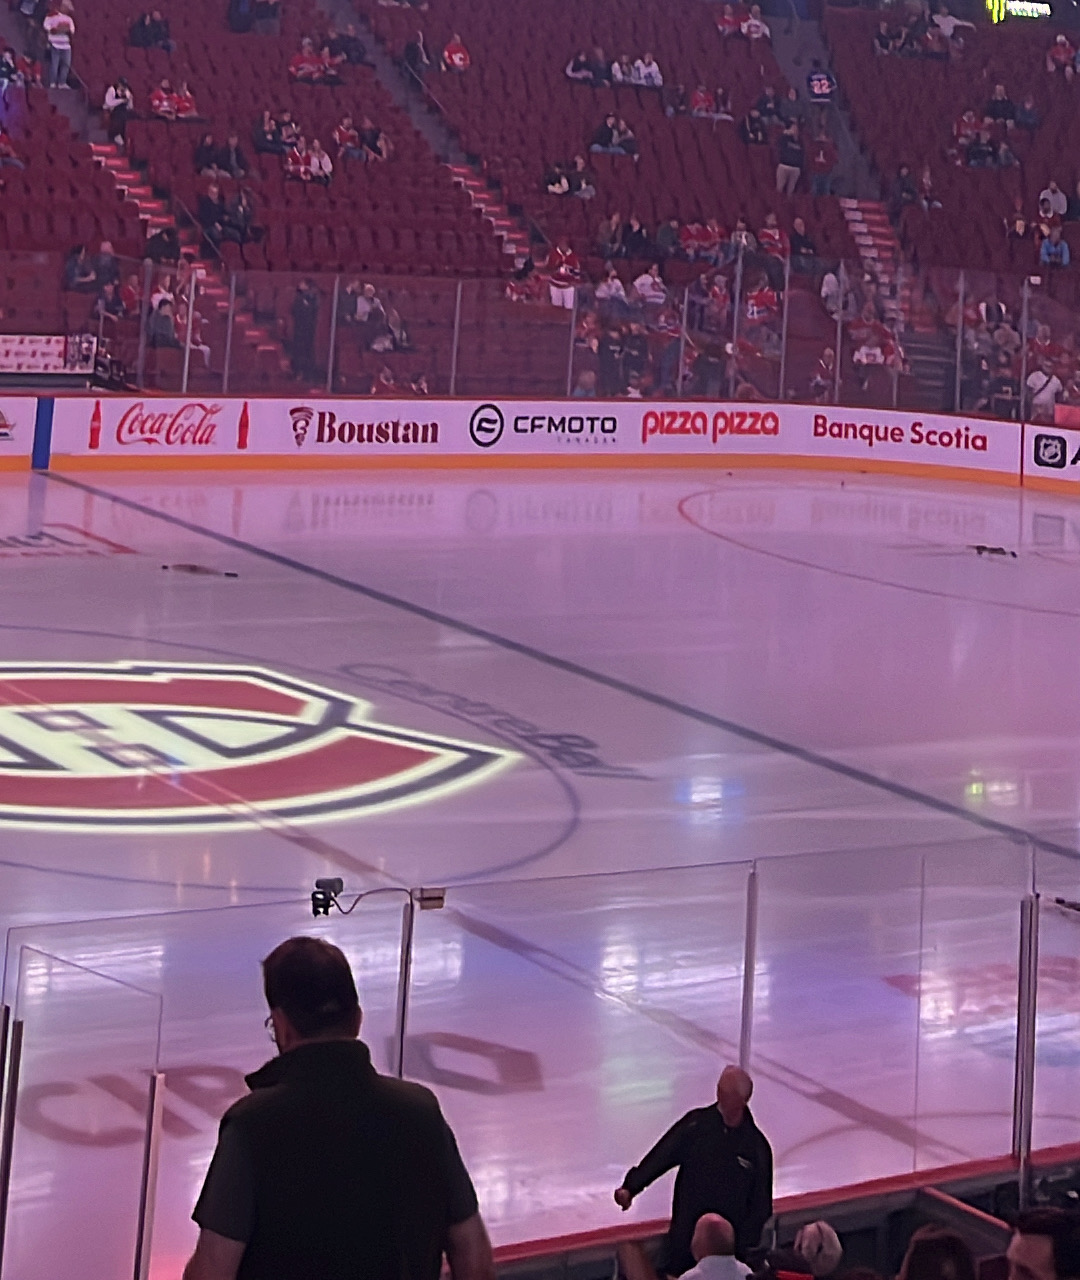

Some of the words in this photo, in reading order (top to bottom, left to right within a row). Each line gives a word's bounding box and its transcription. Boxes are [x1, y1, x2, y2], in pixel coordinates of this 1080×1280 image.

[116, 401, 224, 445] Coca-Cola
[316, 411, 439, 444] Boustan
[513, 415, 617, 434] CFMOTO
[642, 411, 708, 444] pizza
[712, 411, 779, 444] pizza
[813, 415, 905, 447] Banque
[910, 421, 988, 452] Scotia
